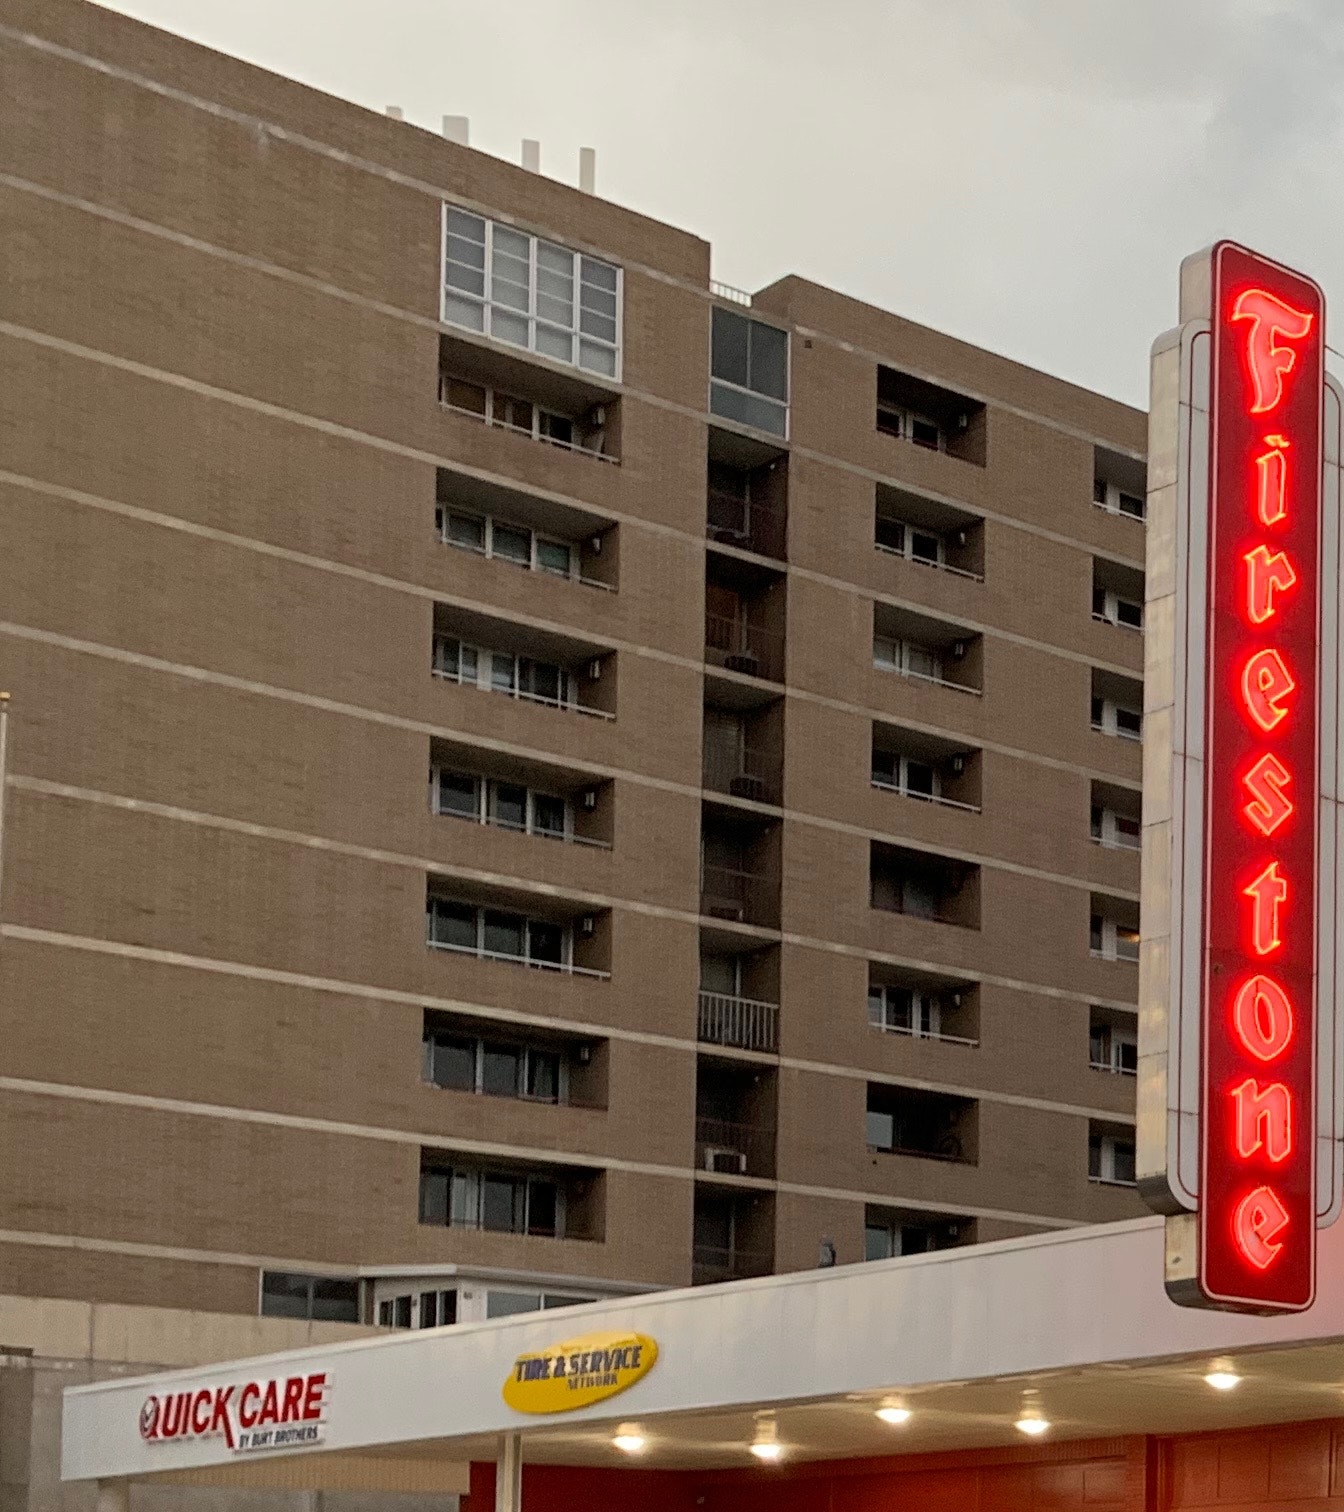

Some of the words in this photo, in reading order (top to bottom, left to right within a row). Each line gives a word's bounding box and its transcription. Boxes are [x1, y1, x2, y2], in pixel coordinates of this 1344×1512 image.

[1228, 287, 1315, 1272] Firestone
[515, 1357, 552, 1382] TIRE
[567, 1345, 643, 1376] SERVICE
[139, 1386, 235, 1449] QUICK
[239, 1373, 326, 1429] CARE
[252, 1431, 273, 1446] BURT
[274, 1426, 318, 1445] BROTHERS
